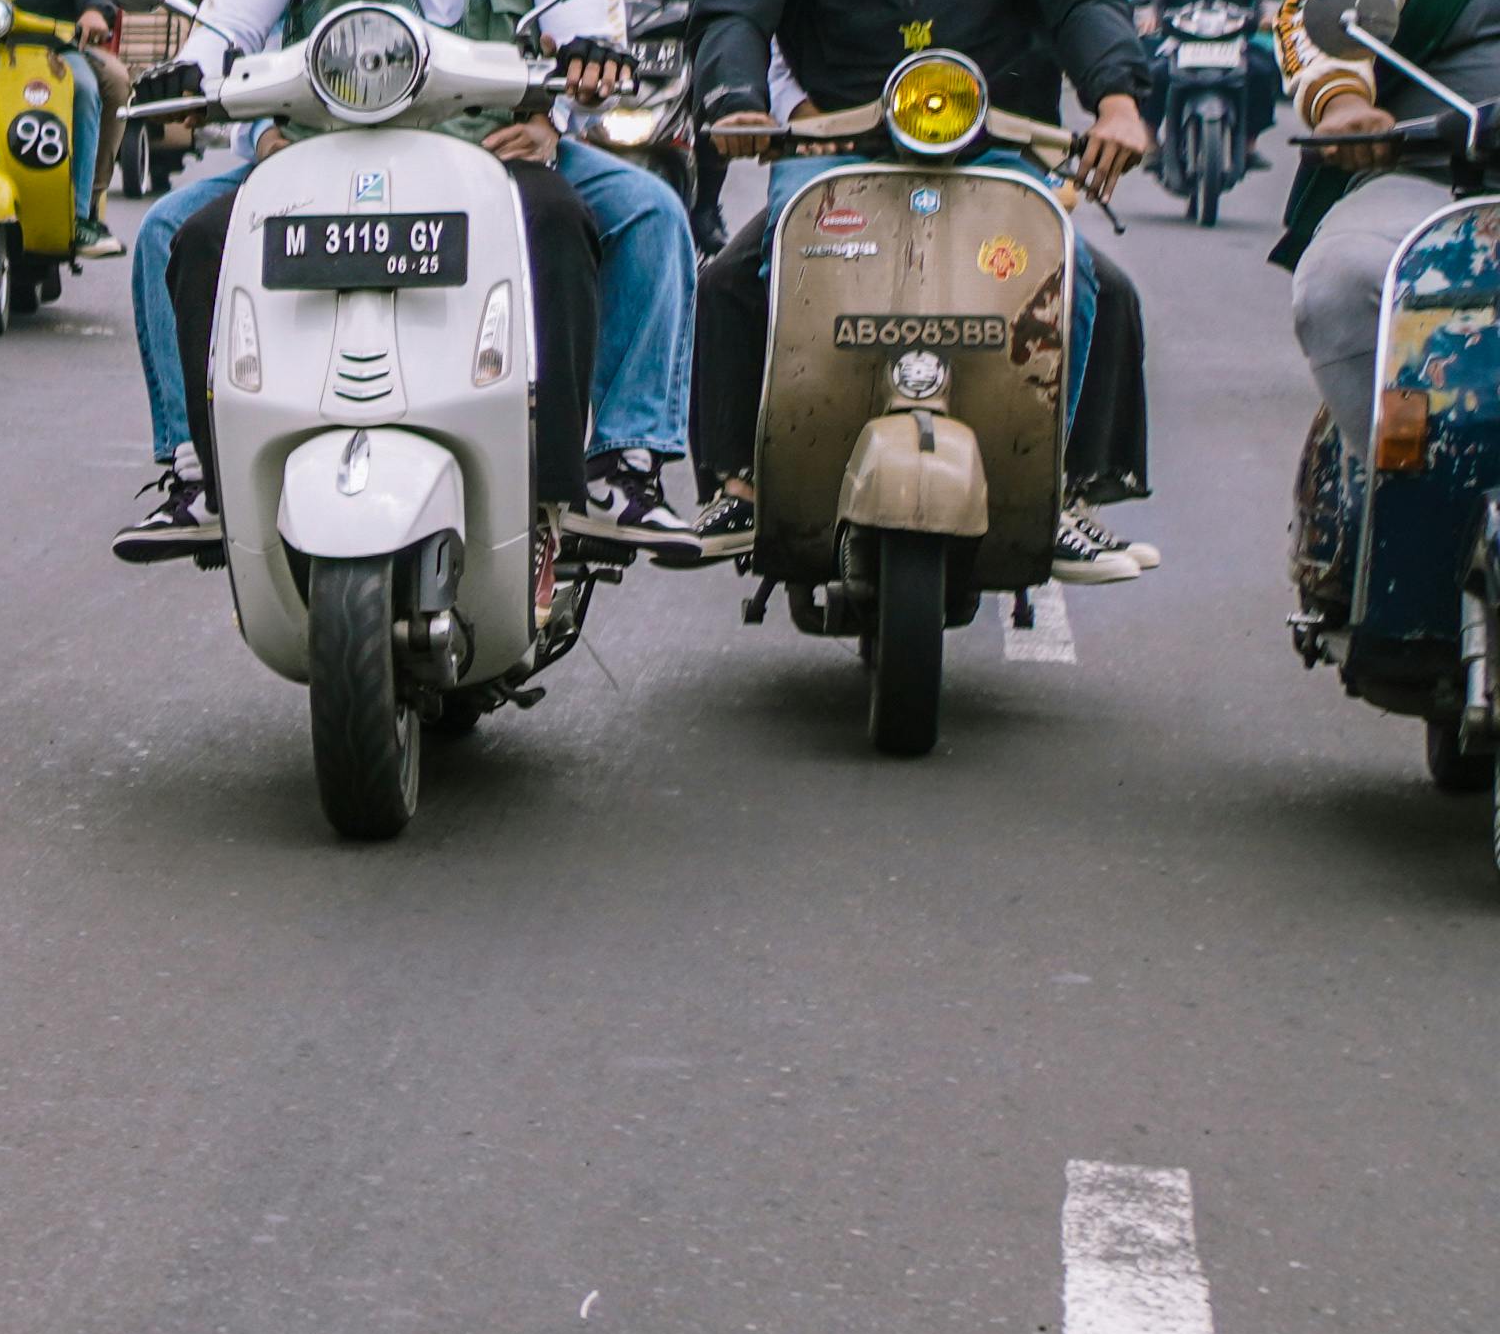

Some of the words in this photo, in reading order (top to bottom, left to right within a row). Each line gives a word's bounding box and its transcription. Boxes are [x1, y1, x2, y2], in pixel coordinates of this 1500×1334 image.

[16, 116, 63, 165] 98
[285, 223, 306, 257] M
[325, 221, 390, 255] 3119
[409, 220, 444, 253] GY
